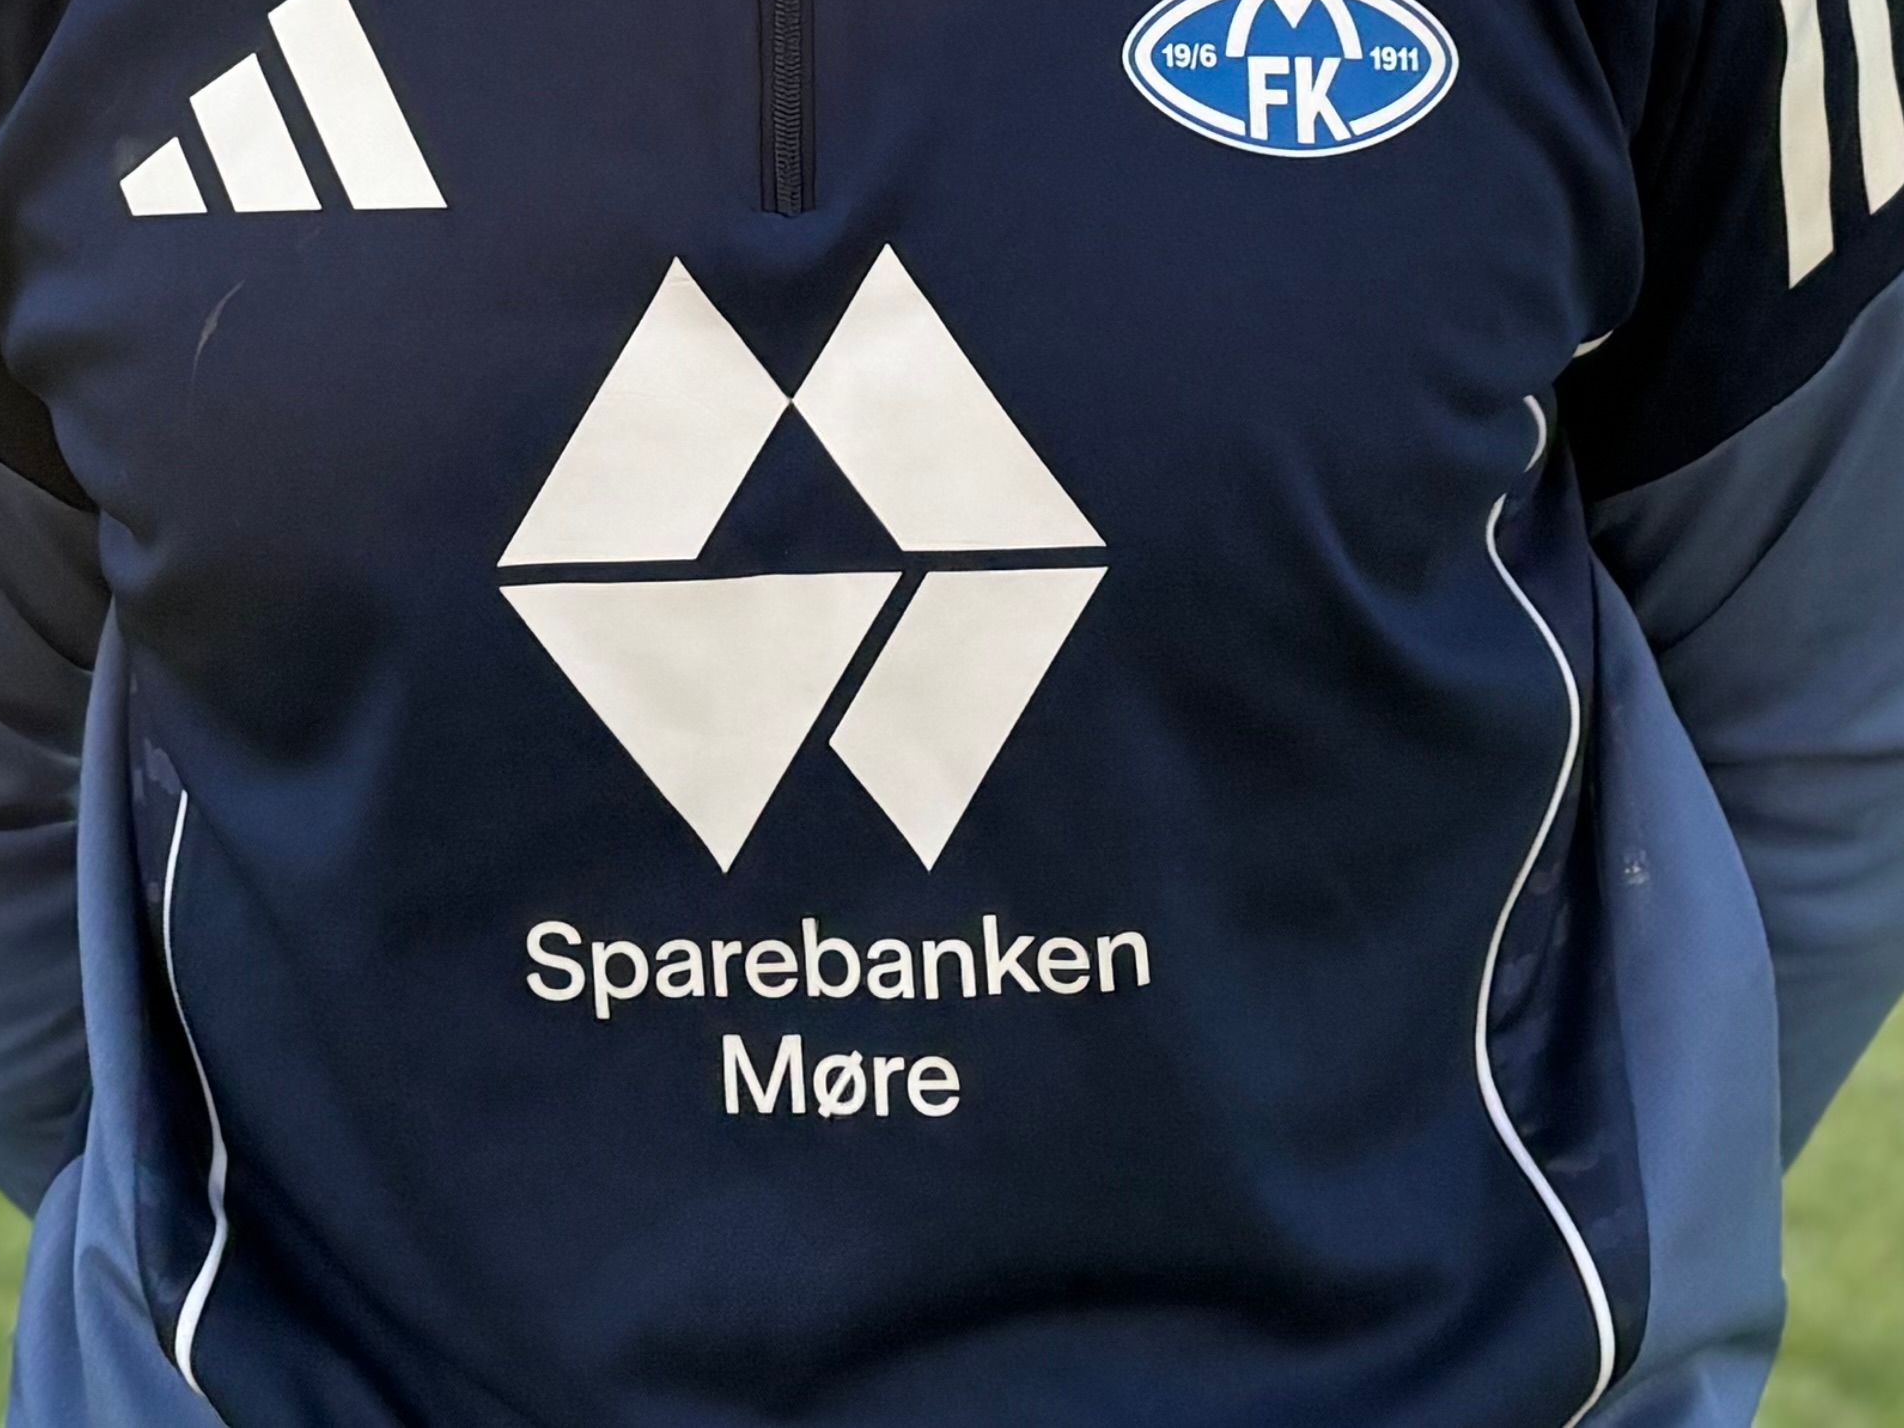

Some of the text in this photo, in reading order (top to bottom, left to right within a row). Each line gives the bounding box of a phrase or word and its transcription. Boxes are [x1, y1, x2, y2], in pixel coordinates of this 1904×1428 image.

[1160, 42, 1218, 71] 19/6
[1368, 45, 1420, 73] 1911
[525, 913, 1152, 1021] Sparebanken
[720, 1032, 962, 1119] Møre
